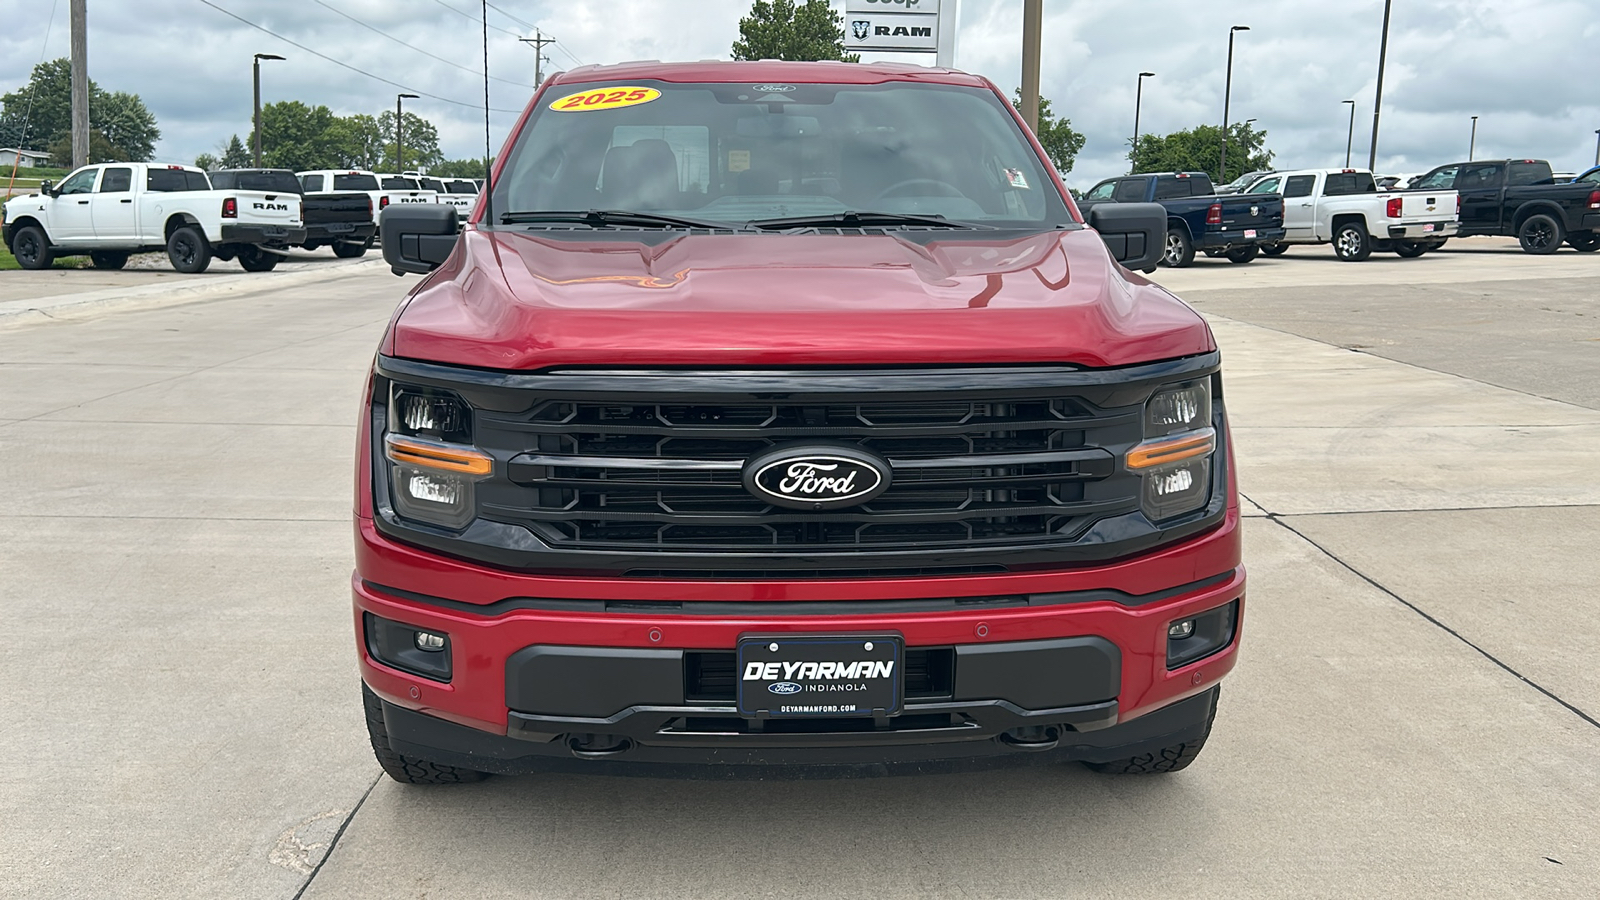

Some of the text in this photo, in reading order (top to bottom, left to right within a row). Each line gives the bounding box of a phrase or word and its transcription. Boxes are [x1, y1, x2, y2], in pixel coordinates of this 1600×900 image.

[874, 26, 931, 37] RAM
[560, 89, 649, 109] 2025
[253, 203, 288, 211] RAM
[779, 462, 857, 493] Ford
[742, 661, 894, 681] DEYARMAN
[805, 683, 867, 692] INDIANOLA
[781, 704, 856, 713] DEYARMANFORD.COM
